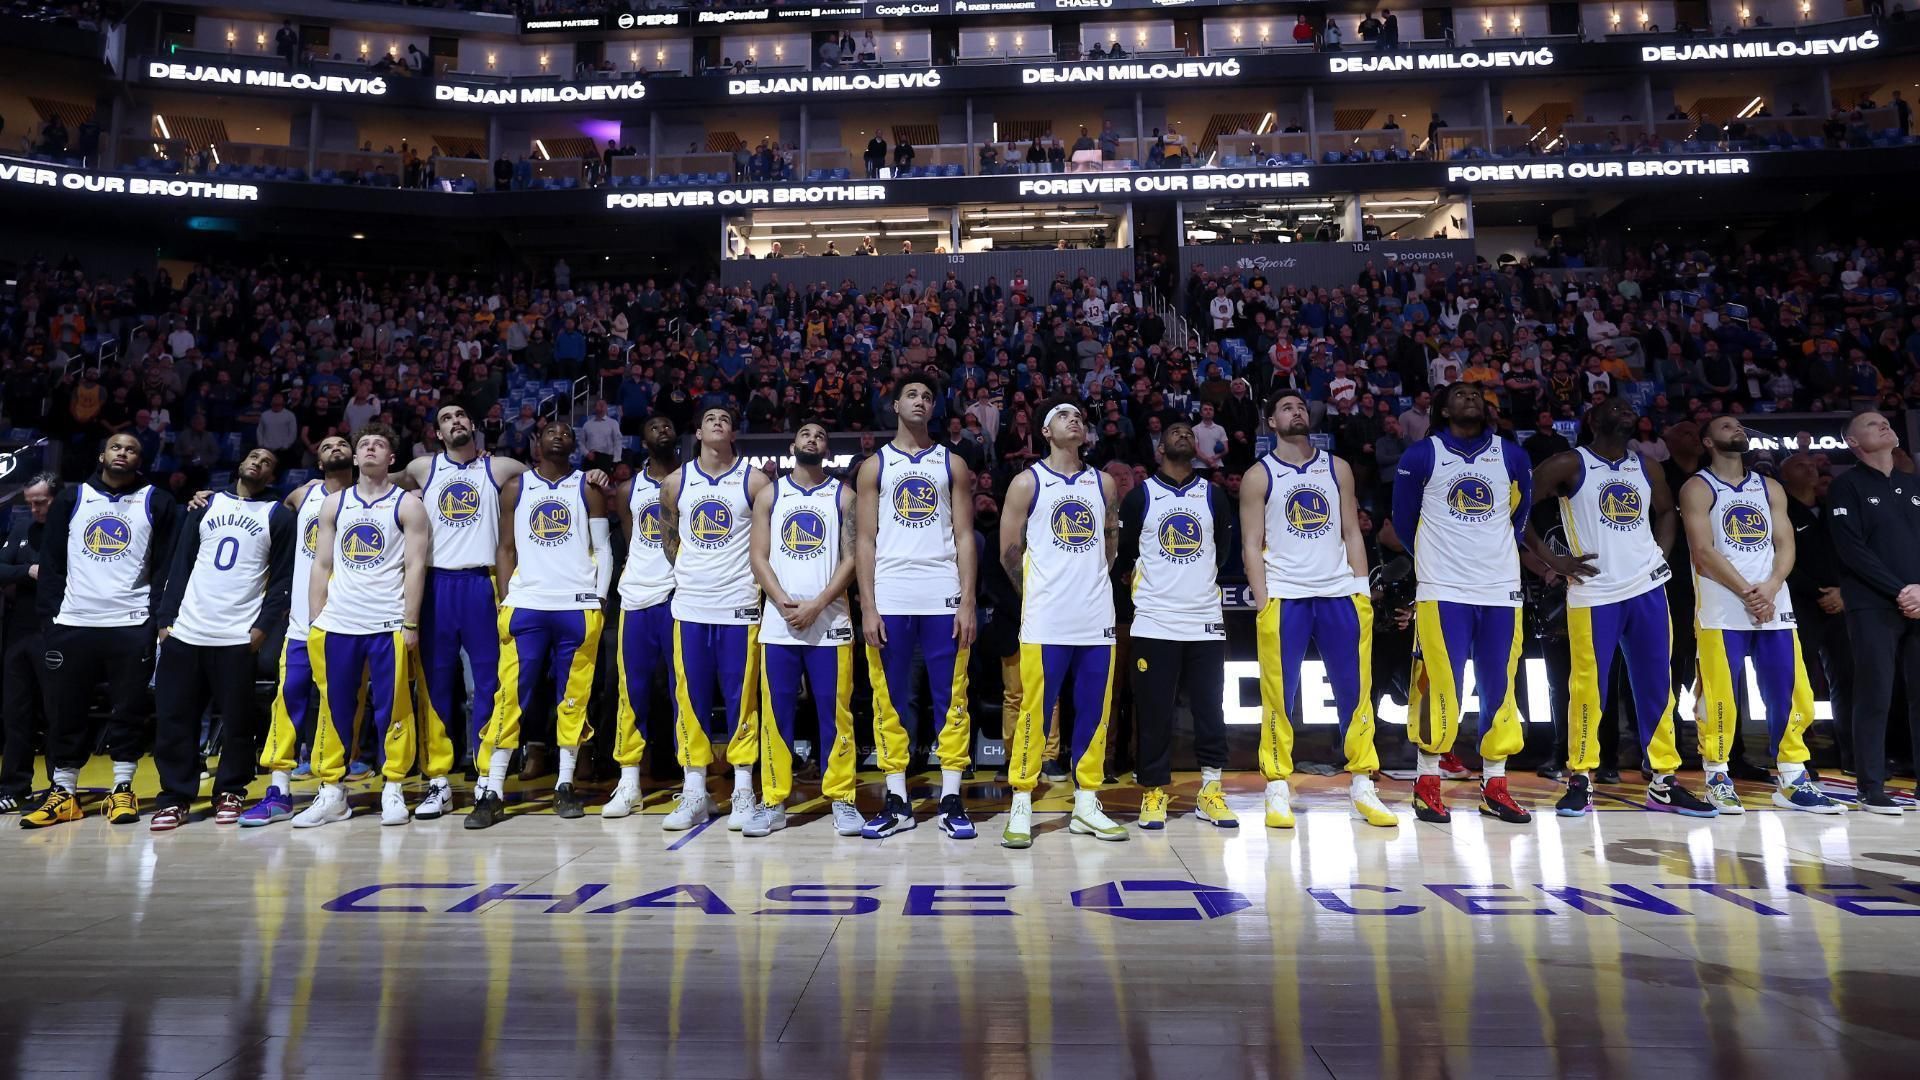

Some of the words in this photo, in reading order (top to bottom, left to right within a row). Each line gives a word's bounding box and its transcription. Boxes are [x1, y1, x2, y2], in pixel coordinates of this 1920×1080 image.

[698, 9, 768, 22] RingCentral
[876, 4, 910, 16] Google
[912, 4, 939, 13] Cloud
[563, 19, 599, 27] PARTNERS
[637, 14, 678, 25] PEPSI
[1642, 44, 1728, 61] DEJAN
[1733, 30, 1879, 58] MILOJEVIĆ
[1330, 56, 1413, 72] DEJAN
[1418, 47, 1553, 69] MILOJEVIĆ
[1023, 66, 1103, 83] DEJAN
[1109, 58, 1240, 80] MILOJEVIĆ
[150, 63, 241, 83] DEJAN
[246, 70, 386, 94] MILOJEVIĆ
[729, 78, 807, 94] DEJAN
[812, 69, 940, 91] MILOJEVIĆ
[436, 86, 517, 104] DEJAN
[521, 81, 645, 102] MILOJEVIĆ
[1448, 164, 1564, 181] FOREVER
[1568, 162, 1623, 178] OUR
[1628, 159, 1749, 176] BROTHER
[63, 174, 124, 192] OUR
[130, 179, 258, 200] BROTHER
[1020, 178, 1131, 195] FOREVER
[1135, 176, 1188, 191] OUR
[1193, 172, 1309, 189] BROTHER
[607, 191, 714, 208] FOREVER
[718, 189, 769, 204] OUR
[773, 186, 885, 202] BROTHER
[1353, 243, 1370, 252] 104
[947, 255, 964, 263] 103
[1253, 256, 1296, 271] Sports
[1400, 252, 1454, 260] DOORDASH
[1088, 306, 1099, 317] 13
[464, 477, 480, 490] STATE
[892, 471, 918, 486] GOLDEN
[920, 471, 938, 485] STATE
[1447, 471, 1472, 488] GOLDEN
[1474, 472, 1494, 486] STATE
[1597, 478, 1619, 491] GOLDEN
[1621, 478, 1639, 491] STATE
[461, 491, 476, 503] 20
[917, 487, 933, 500] 32
[1283, 483, 1306, 499] GOLDEN
[1308, 483, 1327, 495] STATE
[1475, 487, 1484, 499] 5
[1621, 492, 1637, 505] 23
[530, 495, 554, 509] GOLDEN
[555, 496, 571, 507] STATE
[690, 494, 715, 508] GOLDEN
[717, 494, 733, 508] STATE
[1050, 494, 1074, 510] GOLDEN
[1077, 495, 1094, 509] STATE
[1312, 497, 1320, 510] 11
[1721, 499, 1743, 512] GOLDEN
[1745, 500, 1765, 512] STATE
[86, 511, 114, 523] GOLDEN
[116, 512, 132, 524] STATE
[551, 508, 566, 520] 00
[715, 509, 726, 522] 15
[783, 505, 809, 518] GOLDEN
[810, 505, 827, 519] STATE
[1074, 511, 1090, 524] 25
[1157, 506, 1183, 522] GOLDEN
[1185, 507, 1202, 521] STATE
[1448, 507, 1496, 523] WARRIORS
[207, 514, 263, 537] MILOJEVIC
[343, 518, 369, 530] GOLDEN
[370, 518, 386, 531] STATE
[438, 513, 481, 528] WARRIORS
[812, 520, 816, 532] 1
[892, 511, 940, 529] WARRIORS
[1599, 515, 1645, 532] WARRIORS
[1743, 514, 1761, 526] 30
[115, 526, 122, 538] 4
[1186, 523, 1194, 536] 3
[1286, 520, 1334, 540] WARRIORS
[371, 533, 379, 545] 2
[528, 531, 573, 547] WARRIORS
[639, 534, 663, 549] WARRI
[690, 533, 733, 550] WARRIORS
[1052, 536, 1099, 554] WARRIORS
[1724, 536, 1771, 553] WARRIORS
[81, 547, 132, 563] WARRIORS
[214, 536, 239, 571] 0
[779, 543, 827, 561] WARRIORS
[1159, 548, 1205, 565] WARRIORS
[320, 883, 1023, 916] CHASE
[1306, 883, 1920, 917] CENTE
